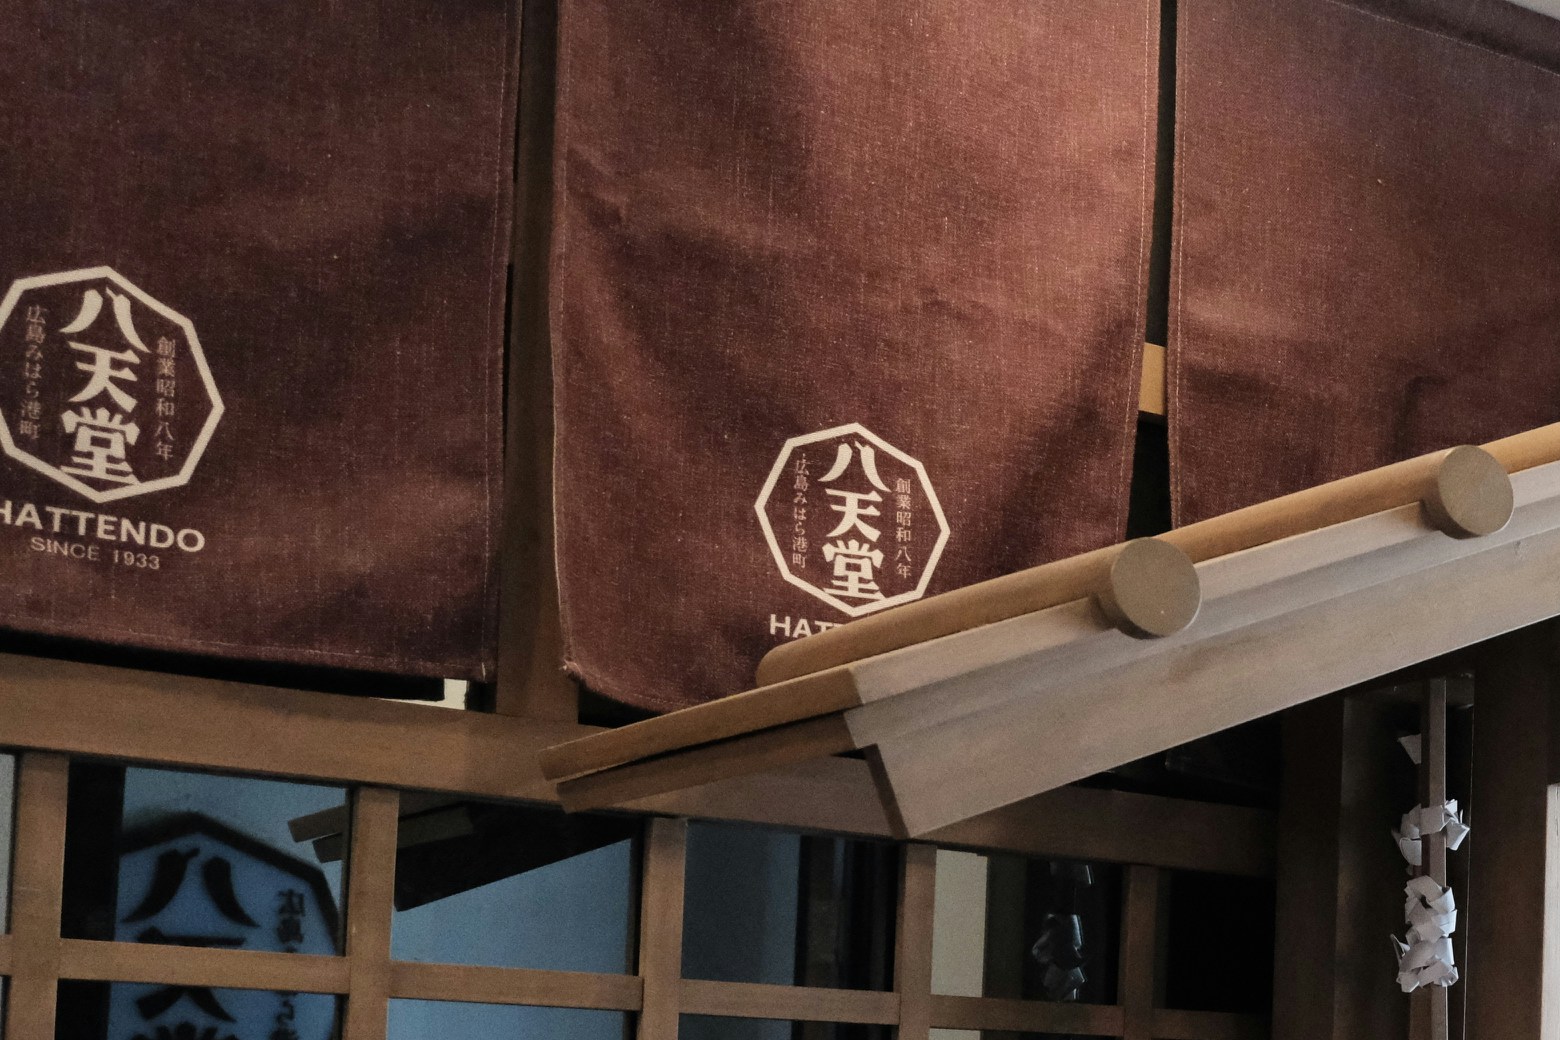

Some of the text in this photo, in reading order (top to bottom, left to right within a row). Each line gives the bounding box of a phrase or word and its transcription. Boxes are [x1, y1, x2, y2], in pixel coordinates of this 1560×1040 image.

[20, 304, 47, 440] 広島みはら港町
[59, 287, 150, 485] 八天堂
[155, 336, 176, 461] 創業昭和八年
[30, 536, 160, 570] SINCE 1933
[792, 453, 809, 569] 広島みはら港町
[817, 441, 892, 600] 八天堂
[896, 478, 912, 579] 創業昭和八年
